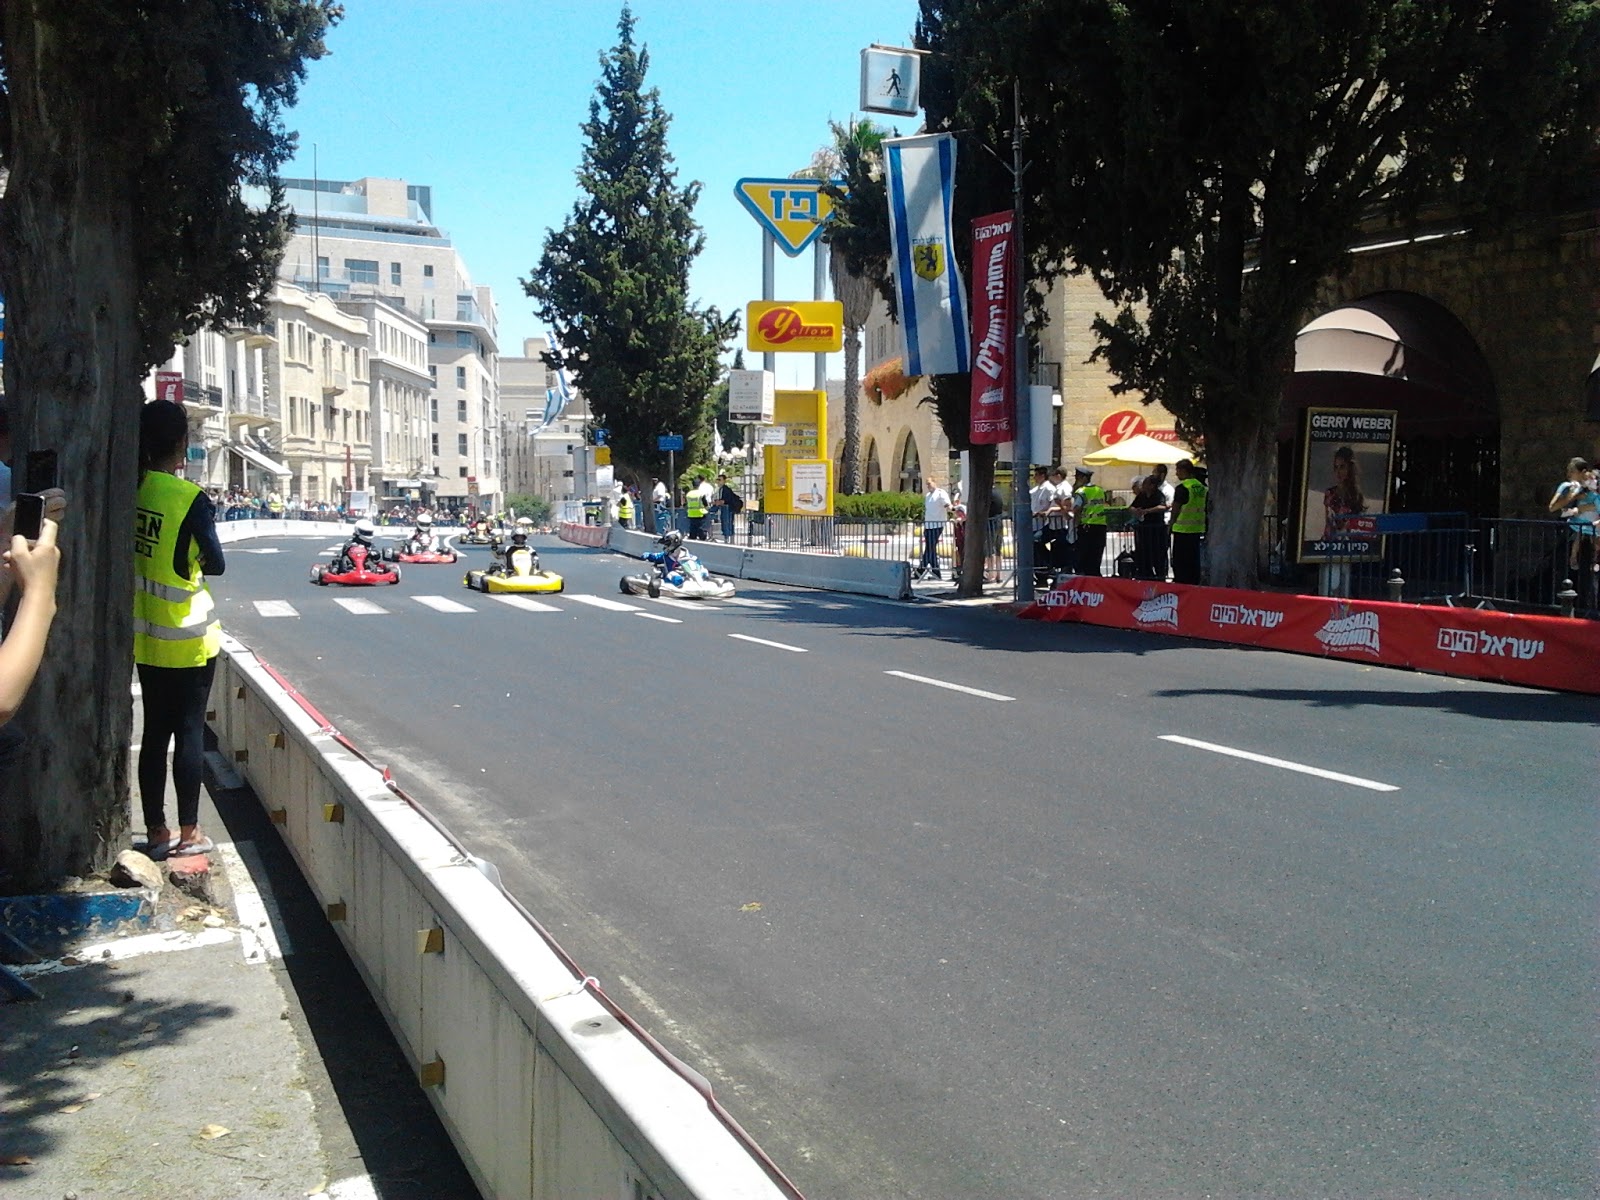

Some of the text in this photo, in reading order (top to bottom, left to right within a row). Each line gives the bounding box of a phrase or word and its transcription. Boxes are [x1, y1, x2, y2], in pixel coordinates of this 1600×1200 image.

[769, 190, 819, 220] פז
[759, 312, 831, 341] Yellow
[976, 305, 1006, 379] ירושלים
[1101, 415, 1177, 442] Yllow
[1312, 415, 1391, 430] GERRY WEBER
[1347, 542, 1369, 552] קניון
[1210, 604, 1284, 628] ישראל היום
[1322, 611, 1379, 633] JERUSALEM
[1324, 629, 1380, 652] FORMULA
[1437, 627, 1544, 659] ישראל היום
